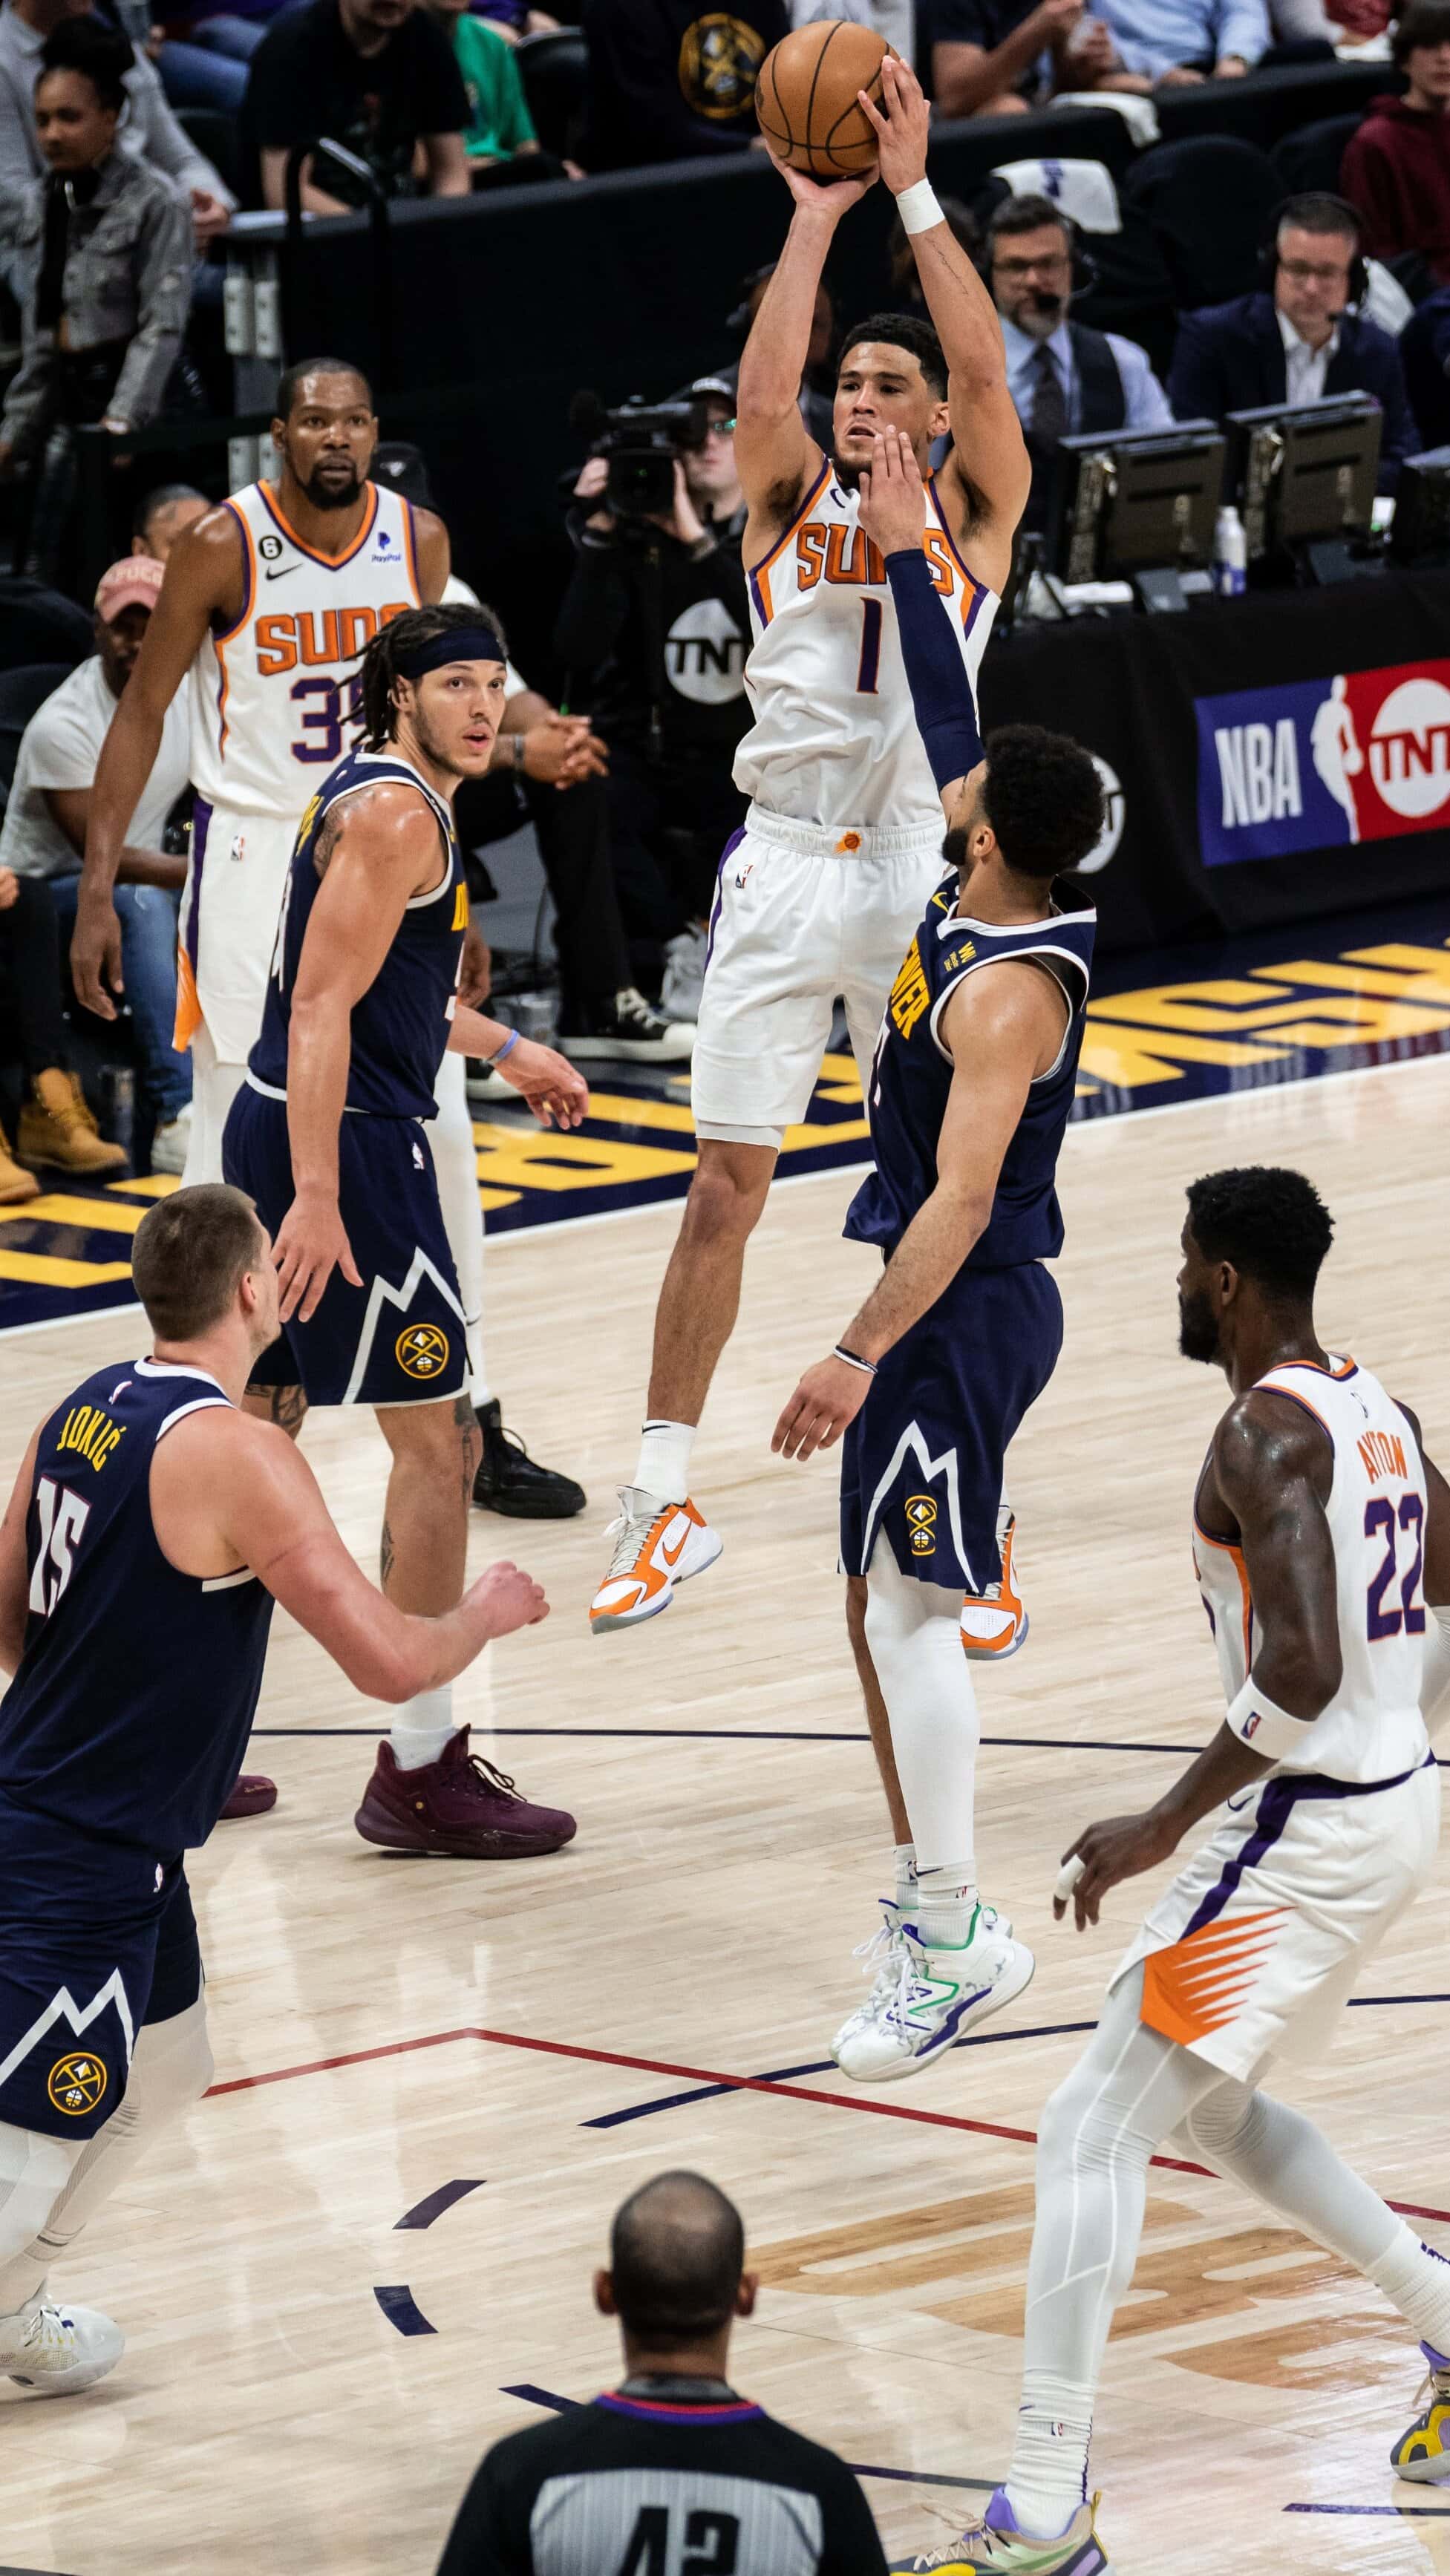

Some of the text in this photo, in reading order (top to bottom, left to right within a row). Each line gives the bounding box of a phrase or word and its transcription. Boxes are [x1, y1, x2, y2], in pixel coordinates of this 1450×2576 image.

[371, 553, 402, 563] PayPal
[856, 595, 882, 695] 1
[1215, 717, 1303, 830] NBA
[56, 1405, 127, 1473] JOKIĆ
[1356, 1430, 1408, 1485] AYTON
[29, 1473, 93, 1619] 15
[1365, 1491, 1426, 1644] 22
[618, 2507, 741, 2576] 42
